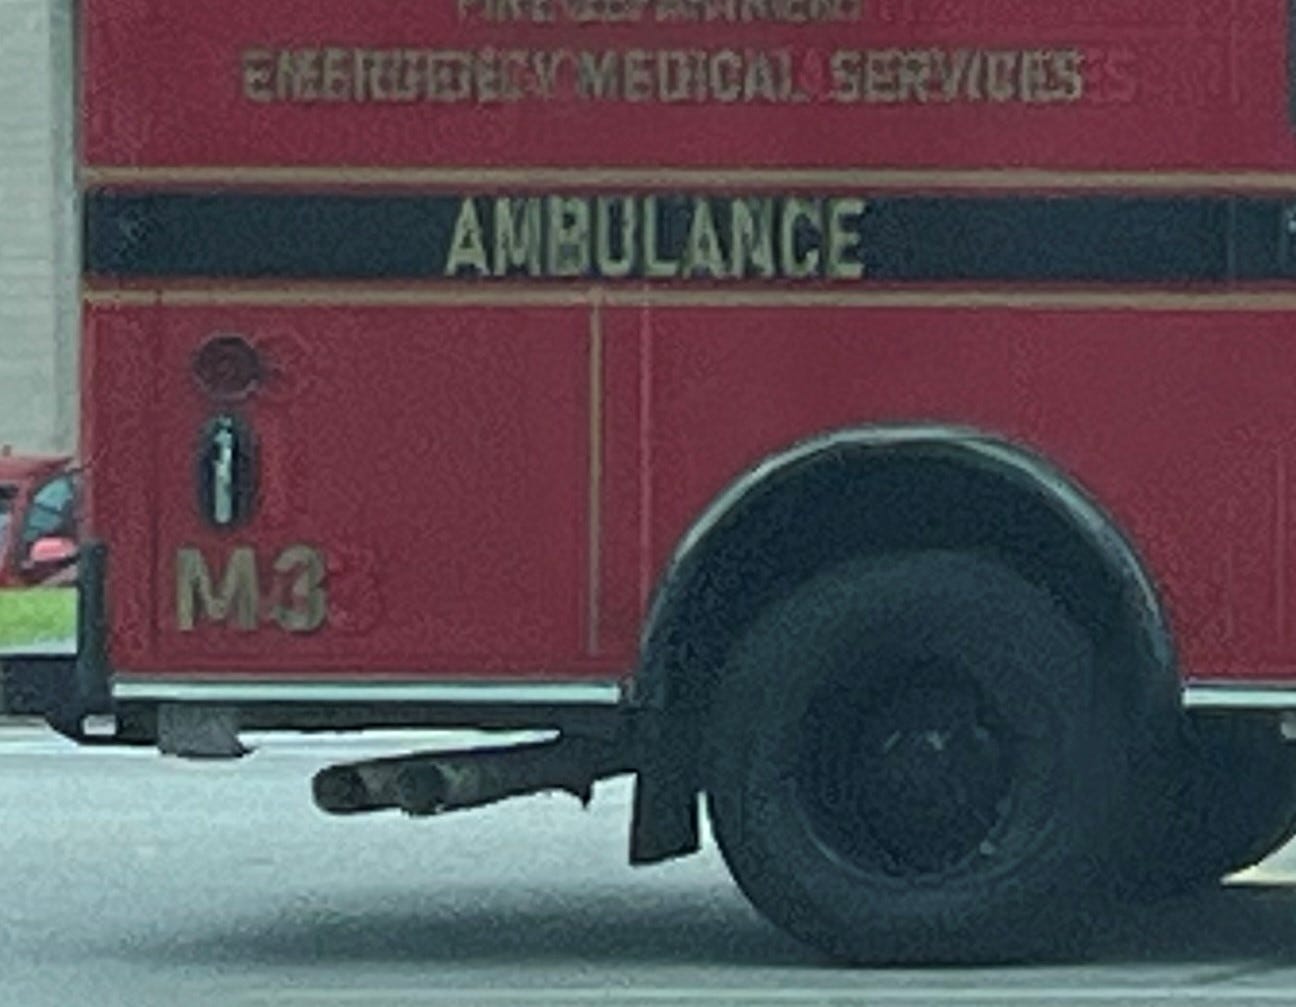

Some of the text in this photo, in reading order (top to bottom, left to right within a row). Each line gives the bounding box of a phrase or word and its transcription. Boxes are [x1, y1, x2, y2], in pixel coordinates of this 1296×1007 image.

[578, 48, 808, 103] MEDICAL
[829, 49, 1083, 103] SERVICES
[444, 196, 866, 278] AMBULANCE
[176, 544, 328, 632] M3
